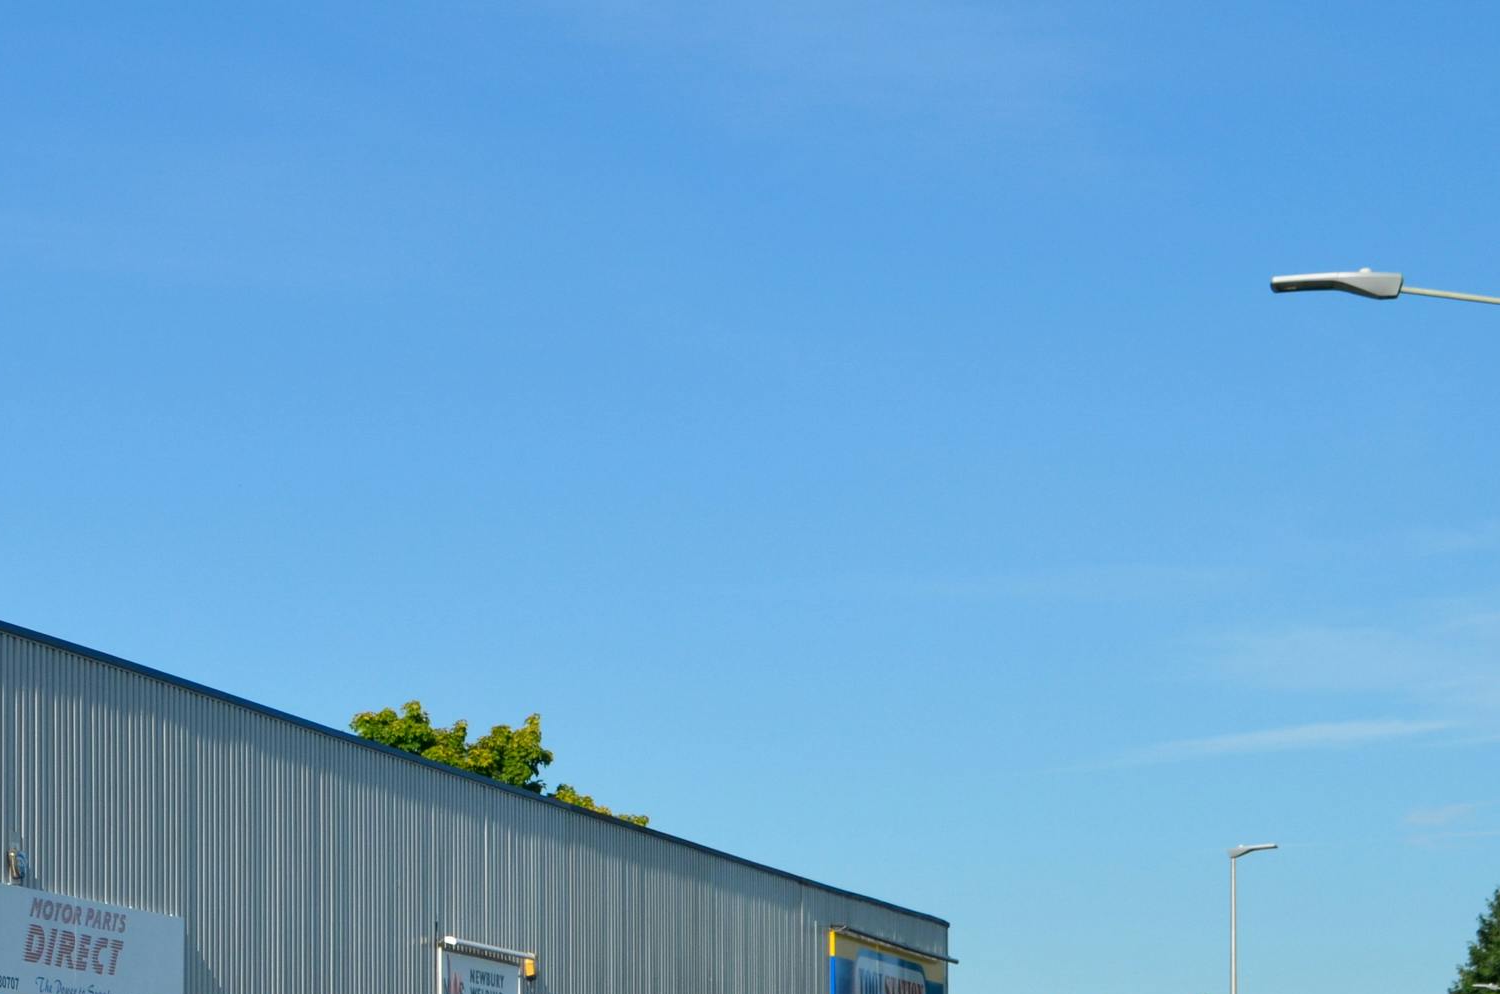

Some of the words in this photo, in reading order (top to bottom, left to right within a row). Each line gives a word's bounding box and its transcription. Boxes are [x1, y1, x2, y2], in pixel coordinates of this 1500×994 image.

[29, 897, 82, 925] MOTOR
[85, 907, 127, 934] PARTS
[22, 924, 124, 976] DIRECT
[469, 969, 504, 988] NEWBURY
